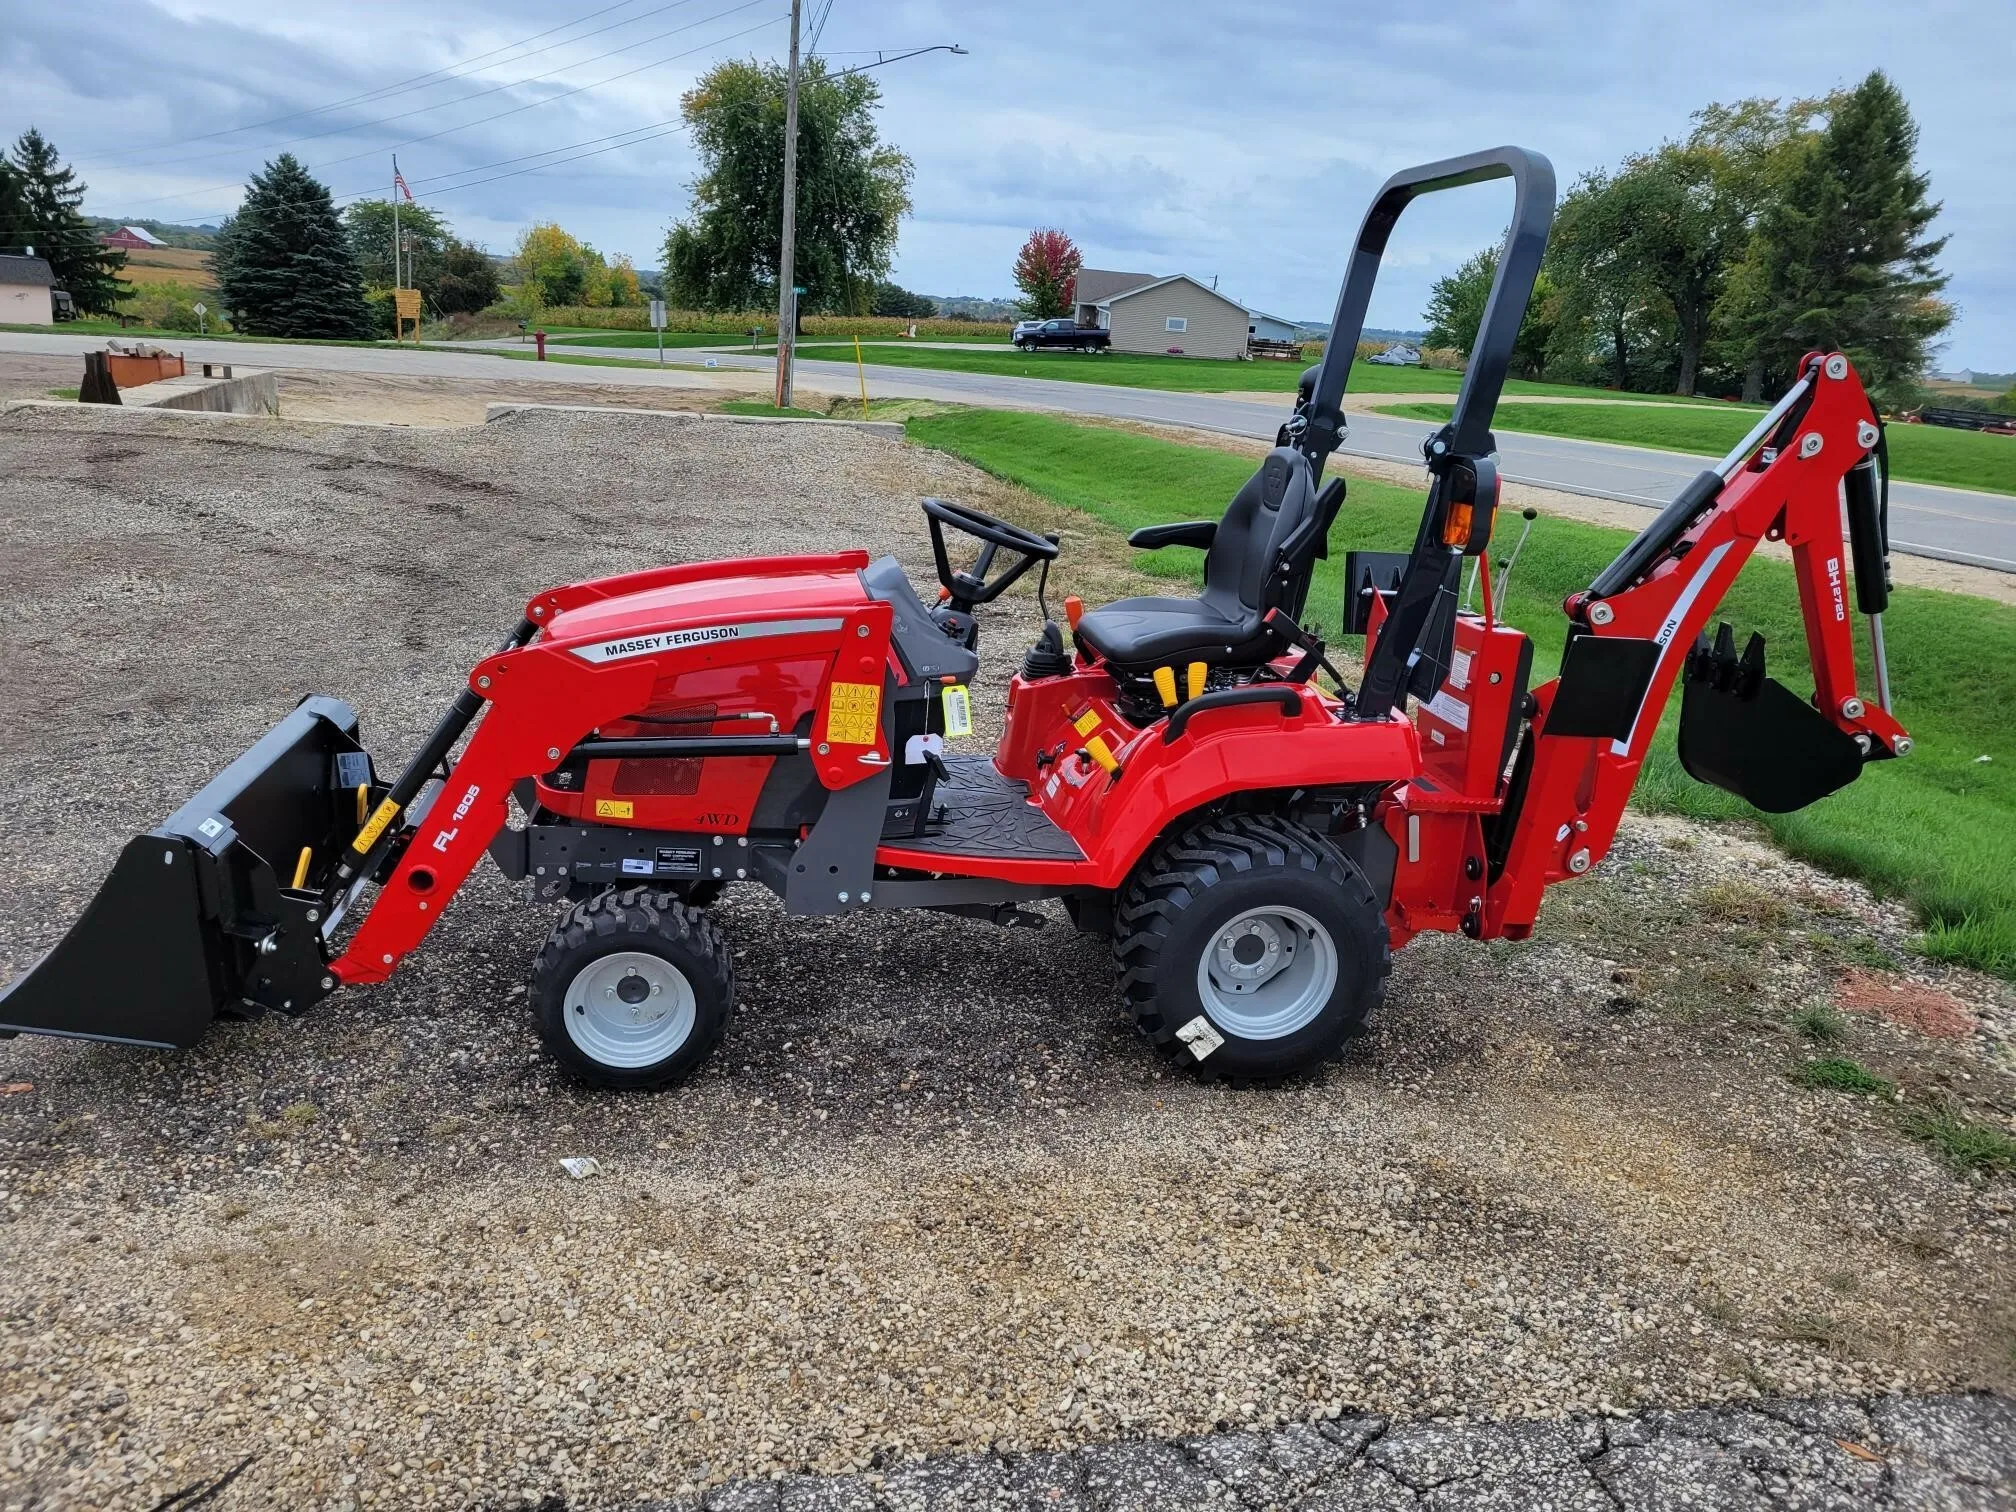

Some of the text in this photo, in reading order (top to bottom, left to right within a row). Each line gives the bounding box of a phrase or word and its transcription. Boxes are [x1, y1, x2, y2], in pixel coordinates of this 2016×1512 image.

[605, 627, 739, 656] MASSEY FERGUSON
[432, 784, 480, 853] FL 1805
[694, 812, 739, 826] 4WD
